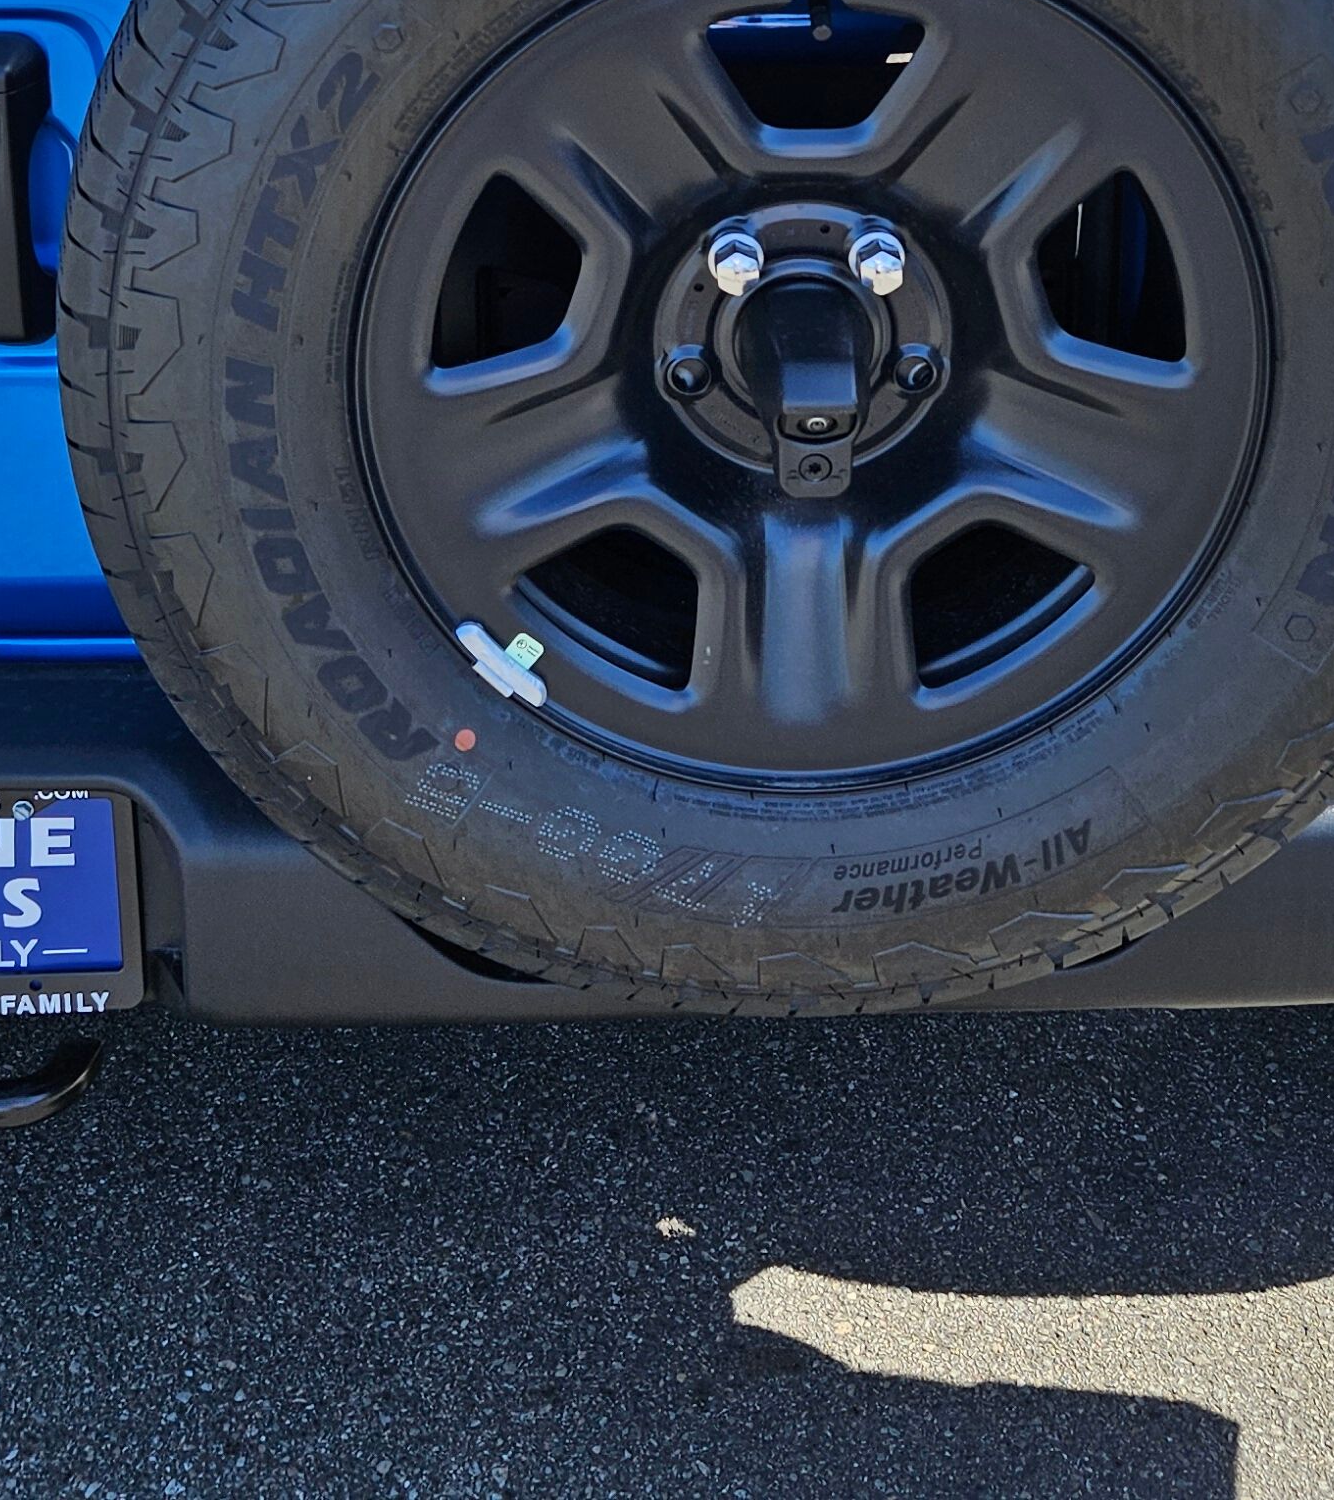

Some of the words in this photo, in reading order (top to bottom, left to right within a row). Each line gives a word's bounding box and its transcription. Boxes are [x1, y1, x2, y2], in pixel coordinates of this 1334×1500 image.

[230, 50, 380, 332] HTX2
[225, 355, 440, 761] ROADIAN
[831, 838, 983, 881] Performance
[831, 817, 1094, 916] All-Weather
[0, 991, 110, 1016] FAMILY
